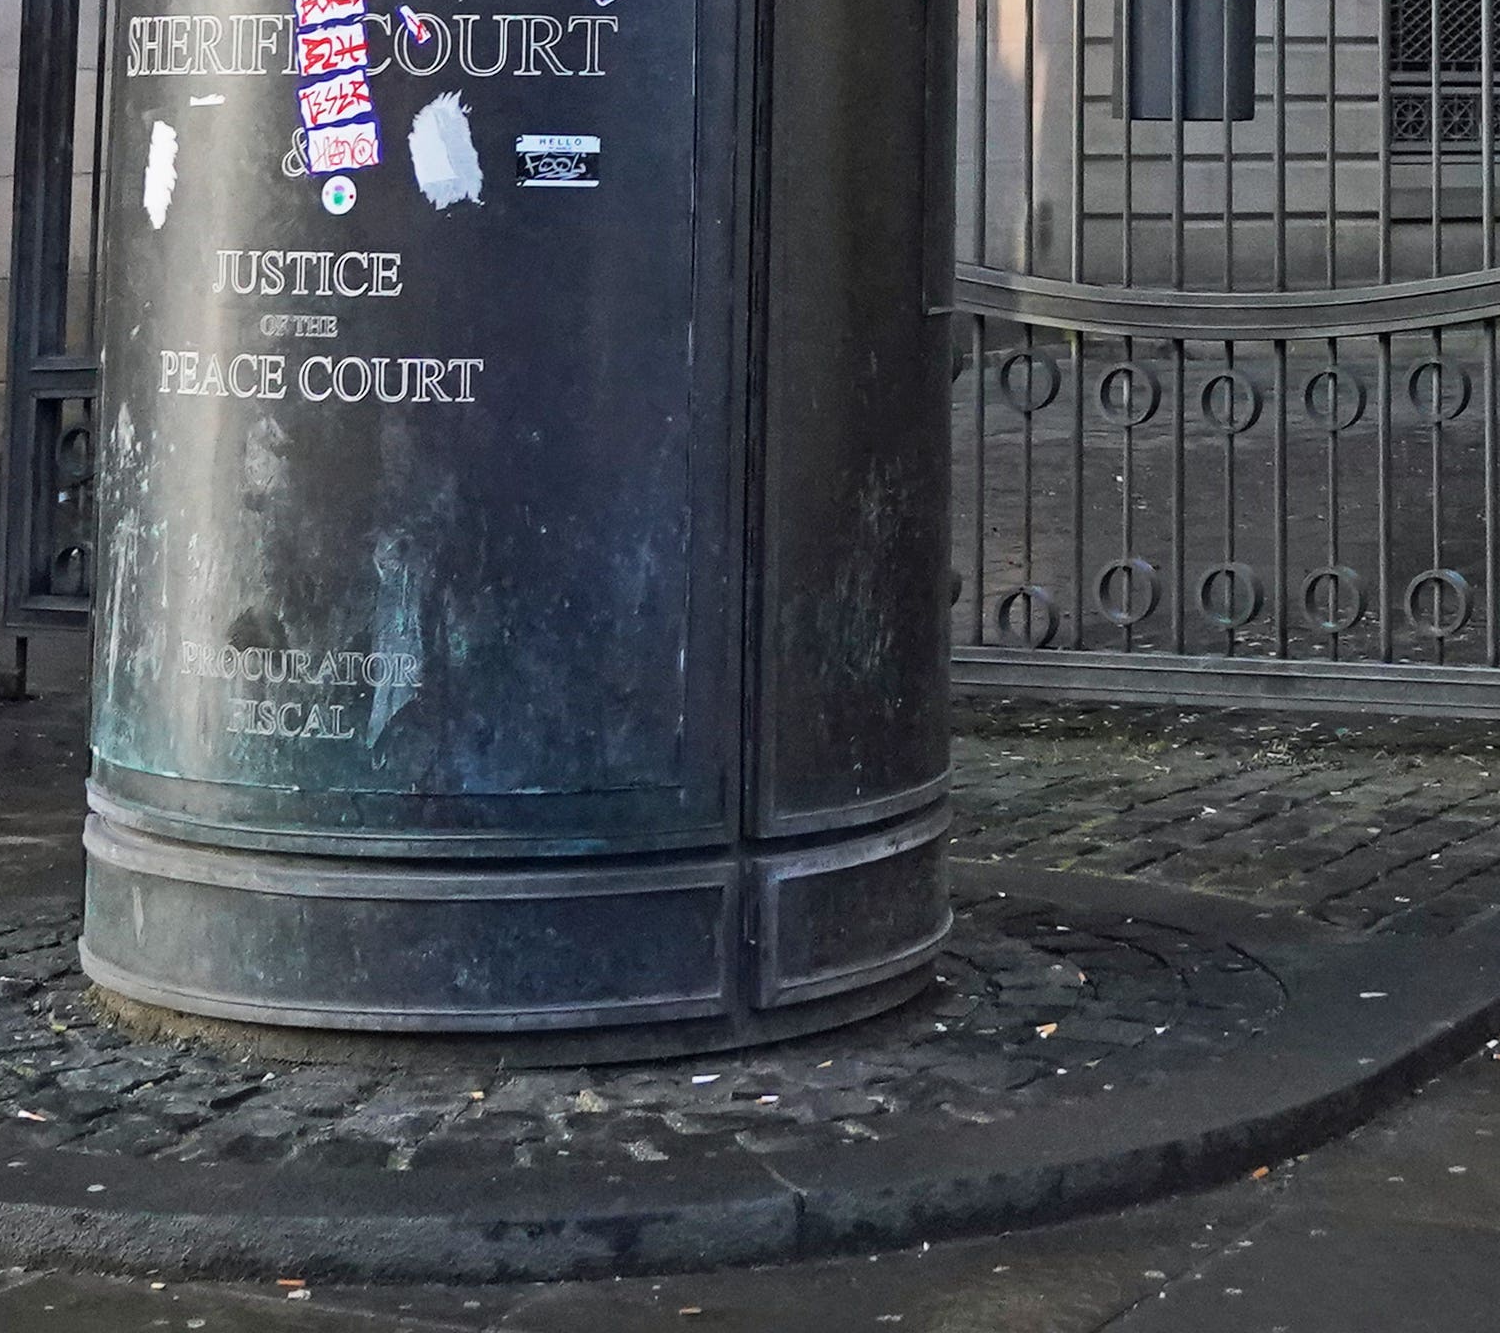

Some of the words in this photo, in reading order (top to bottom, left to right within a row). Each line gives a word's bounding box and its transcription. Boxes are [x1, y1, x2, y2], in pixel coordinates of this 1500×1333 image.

[126, 14, 297, 77] SHERIF
[540, 137, 582, 146] HELLO
[212, 250, 403, 297] JUSTICE
[260, 314, 288, 336] OF
[291, 314, 338, 338] THE
[158, 349, 287, 399] PEACE
[299, 355, 484, 403] COURT
[181, 640, 422, 688] PROCURATOR
[226, 697, 355, 739] FISCAL
